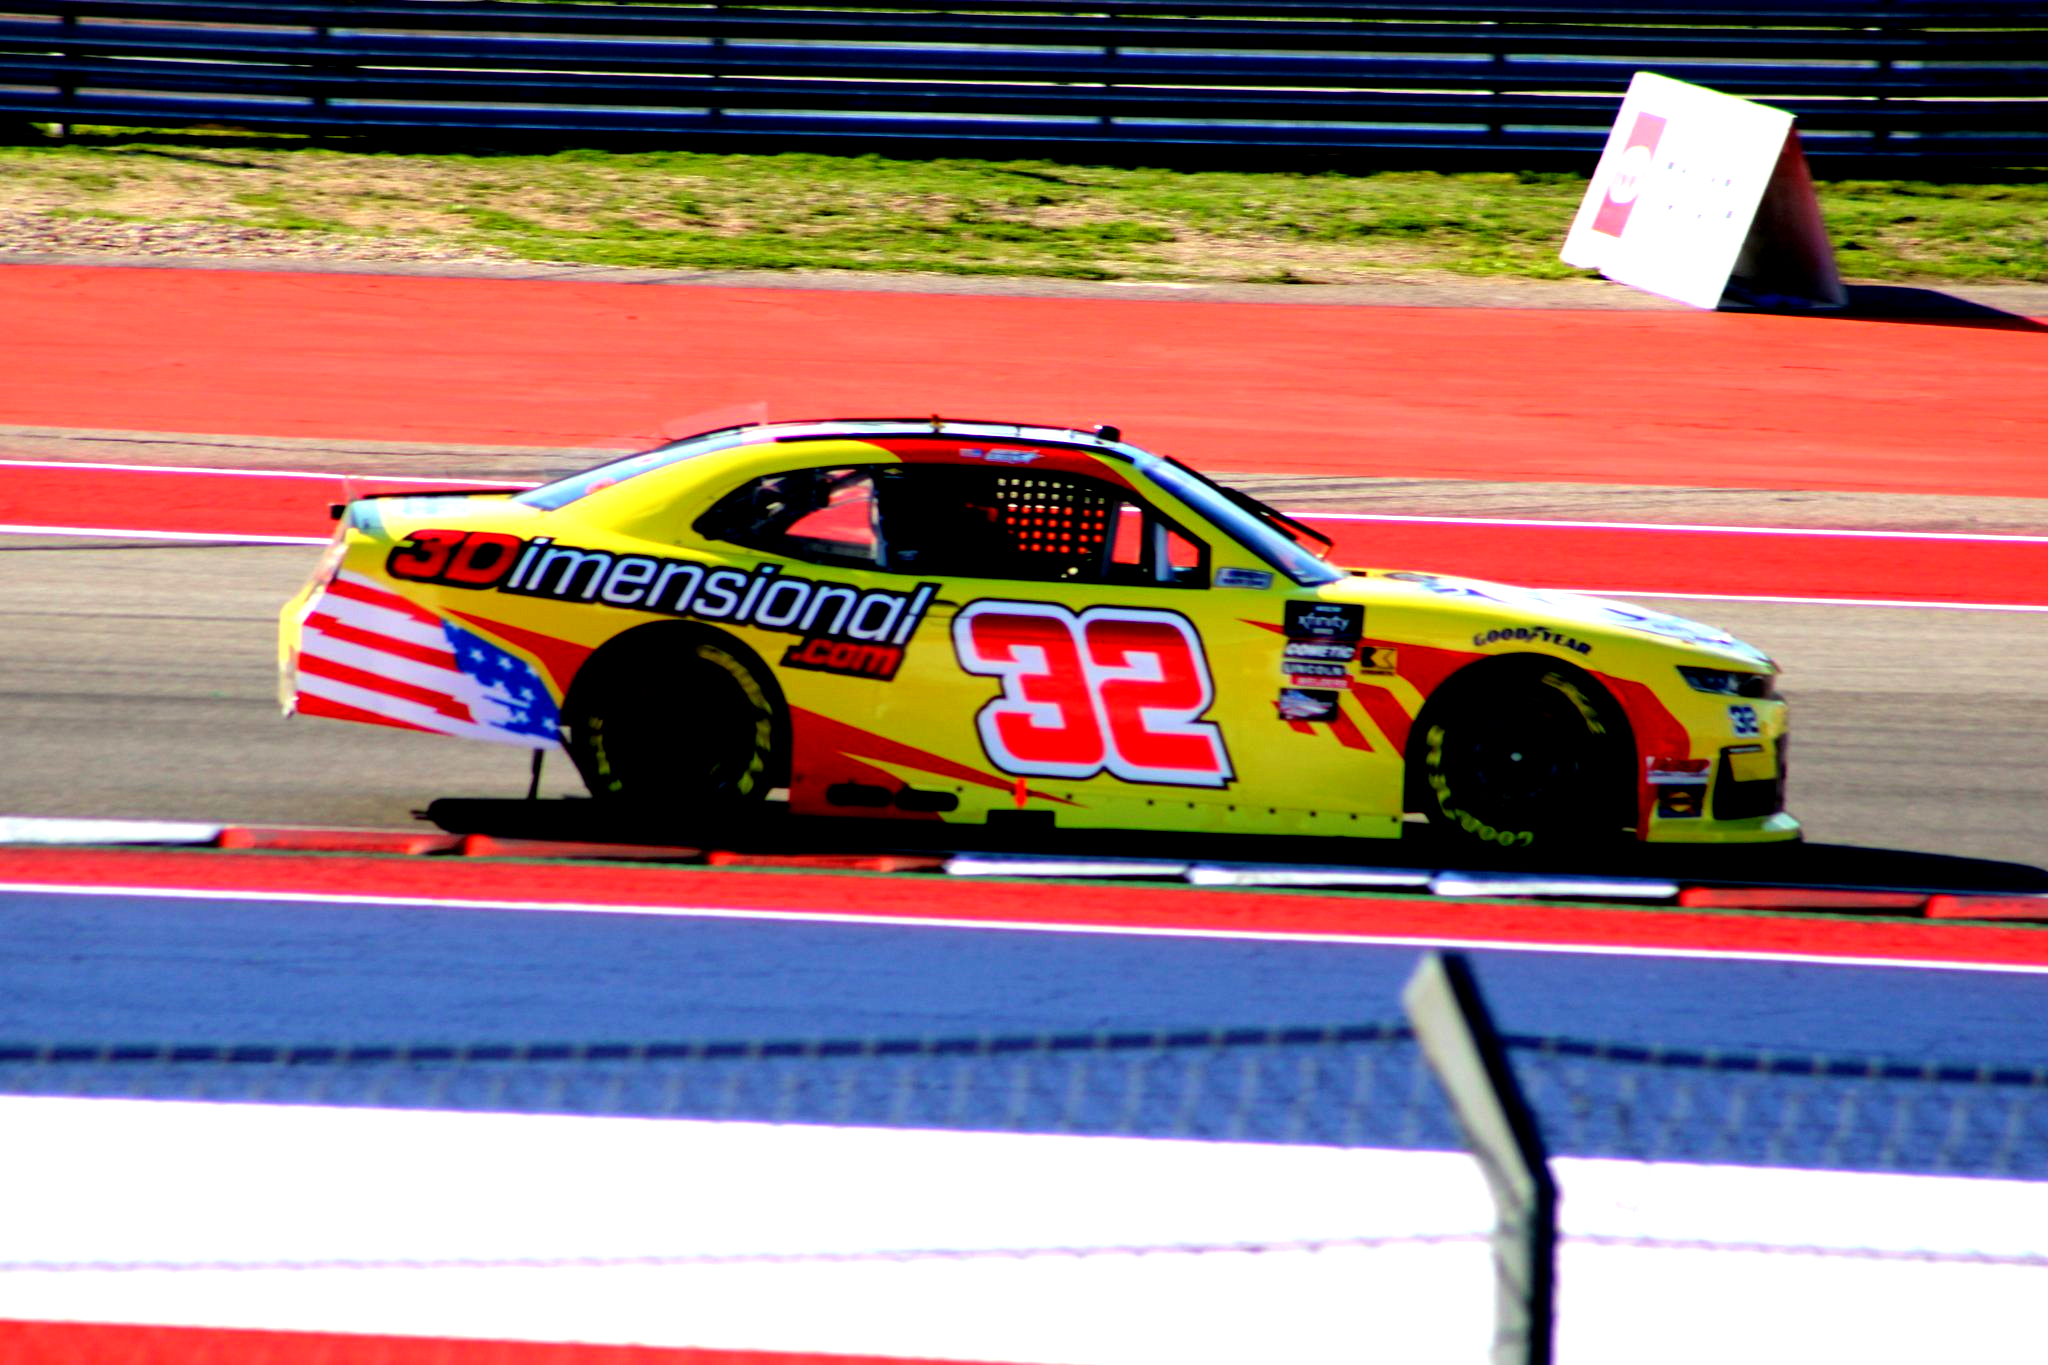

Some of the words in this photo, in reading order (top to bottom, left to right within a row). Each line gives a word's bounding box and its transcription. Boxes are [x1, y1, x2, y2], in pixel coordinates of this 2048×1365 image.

[390, 529, 937, 646] 3Dimensional
[787, 637, 905, 674] .com
[1284, 642, 1356, 660] COMETIC
[1473, 625, 1593, 655] GOODYEAR
[1281, 661, 1346, 677] LINCOLN
[955, 600, 1236, 788] 32
[1729, 704, 1761, 736] 32
